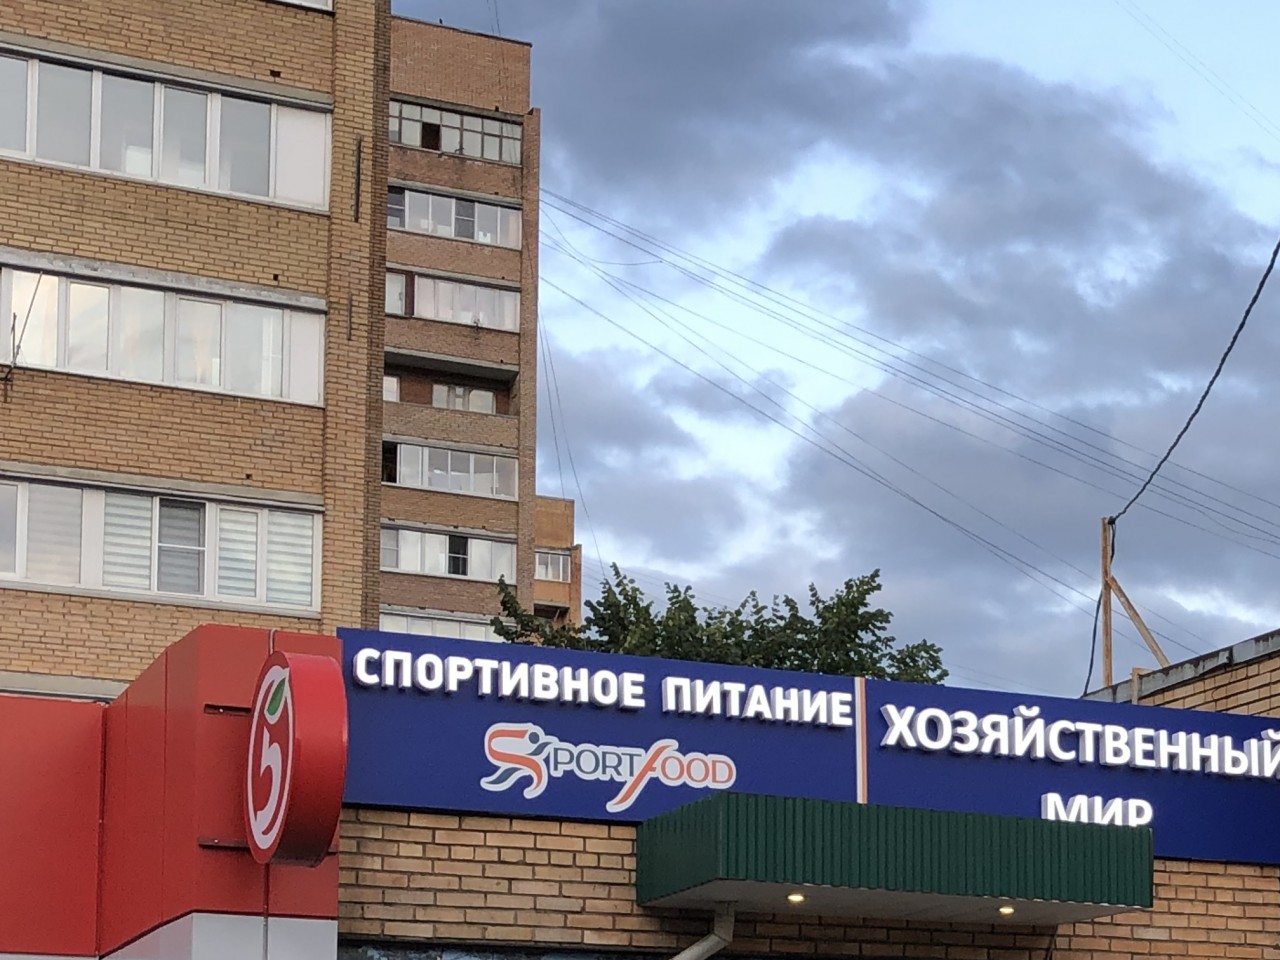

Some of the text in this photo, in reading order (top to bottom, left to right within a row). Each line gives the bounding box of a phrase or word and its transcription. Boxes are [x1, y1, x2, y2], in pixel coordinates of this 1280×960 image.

[353, 647, 854, 728] СПОРТИВНОЕ ПИТАНИЕ
[1040, 791, 1154, 828] МИР
